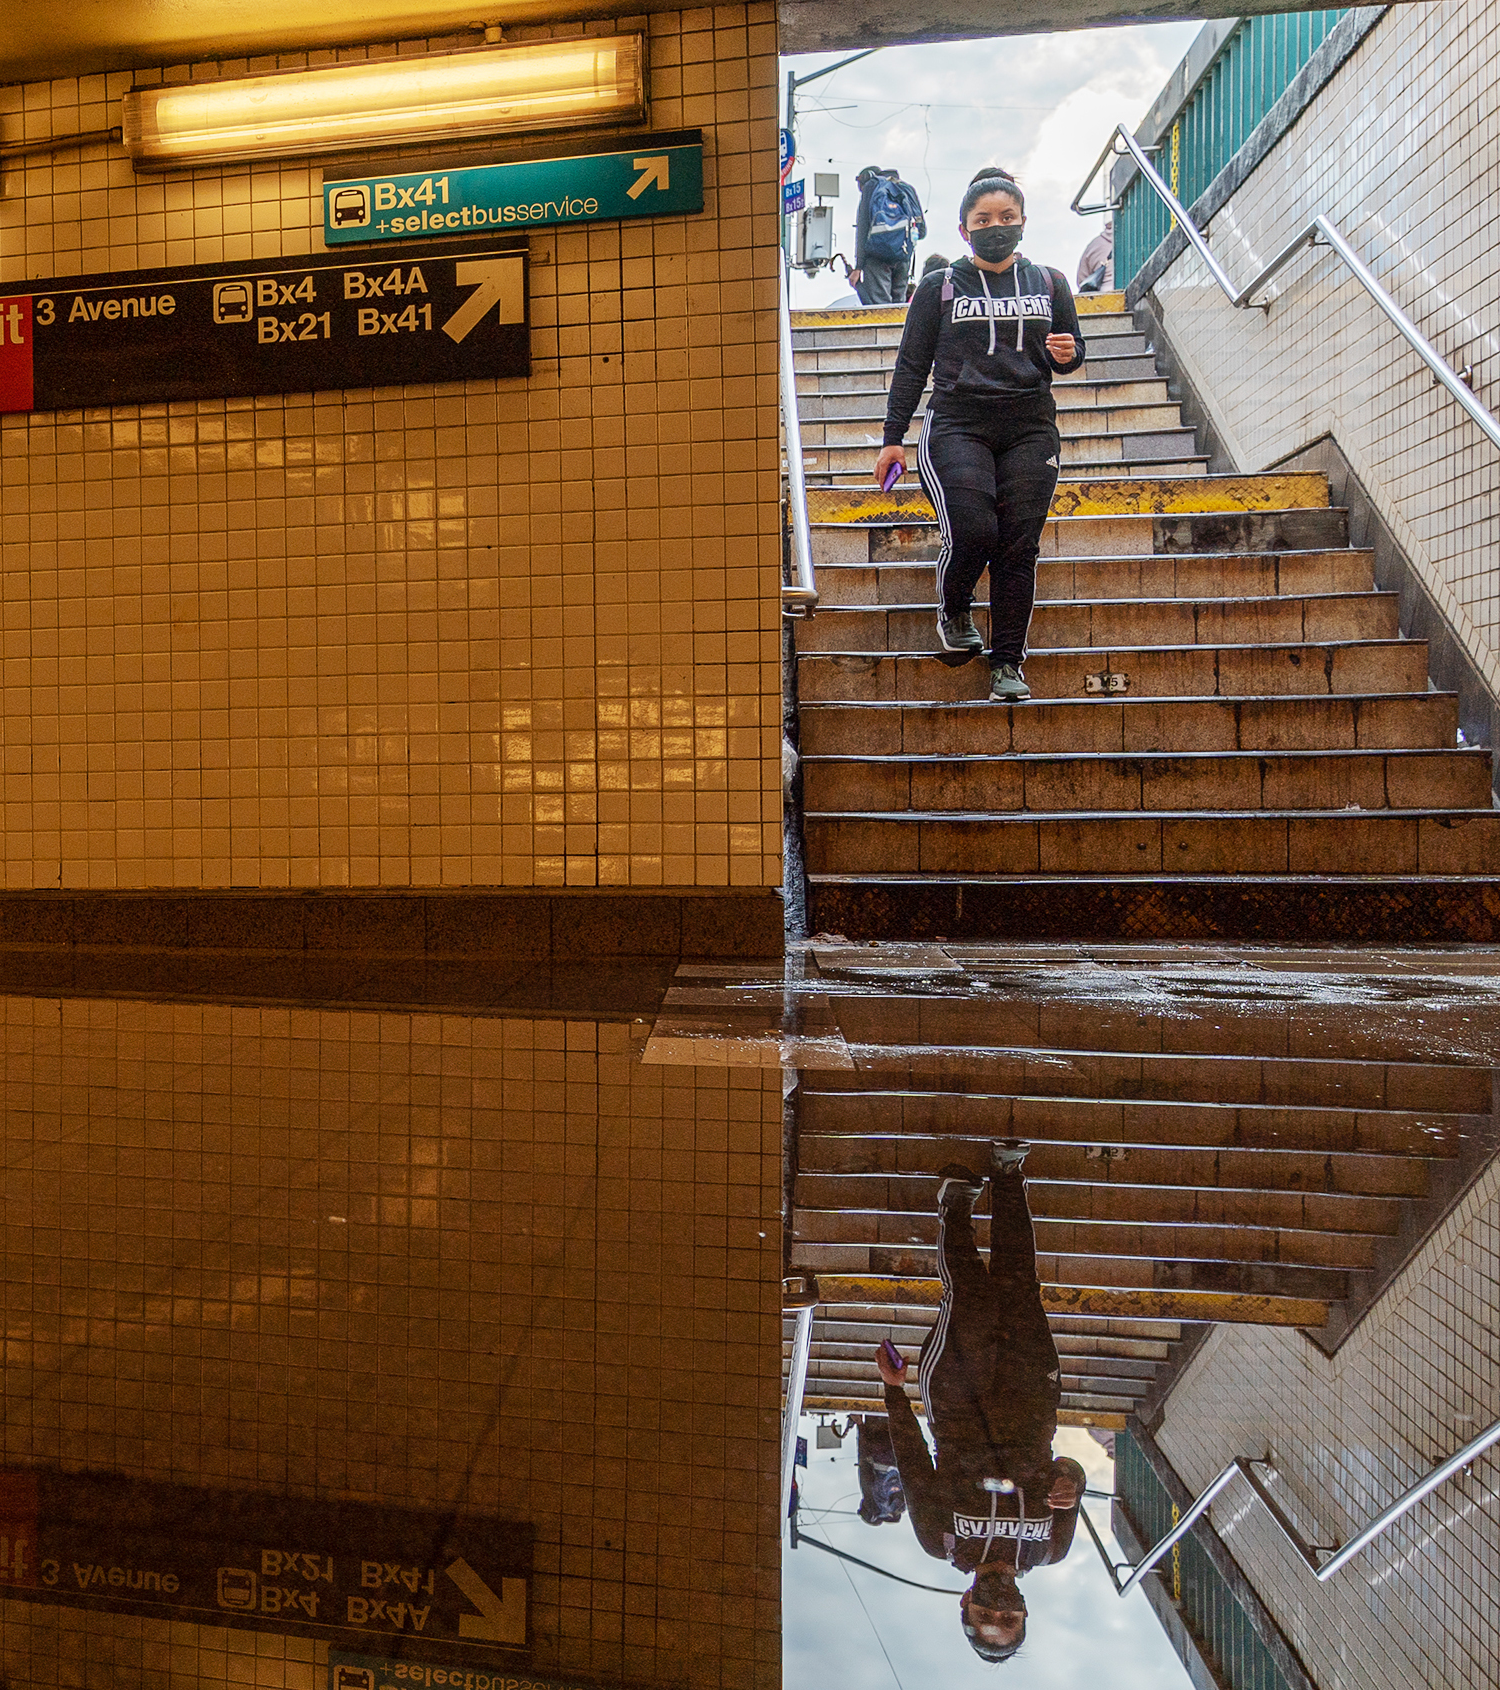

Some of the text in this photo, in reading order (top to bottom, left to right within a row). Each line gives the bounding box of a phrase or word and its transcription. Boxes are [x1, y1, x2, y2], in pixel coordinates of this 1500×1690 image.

[375, 177, 449, 211] Bx41
[786, 182, 801, 198] Bx15
[257, 267, 428, 306] Bx4 Bx4A
[36, 294, 176, 325] 3 Avenue
[258, 303, 432, 344] Bx21 Bx41
